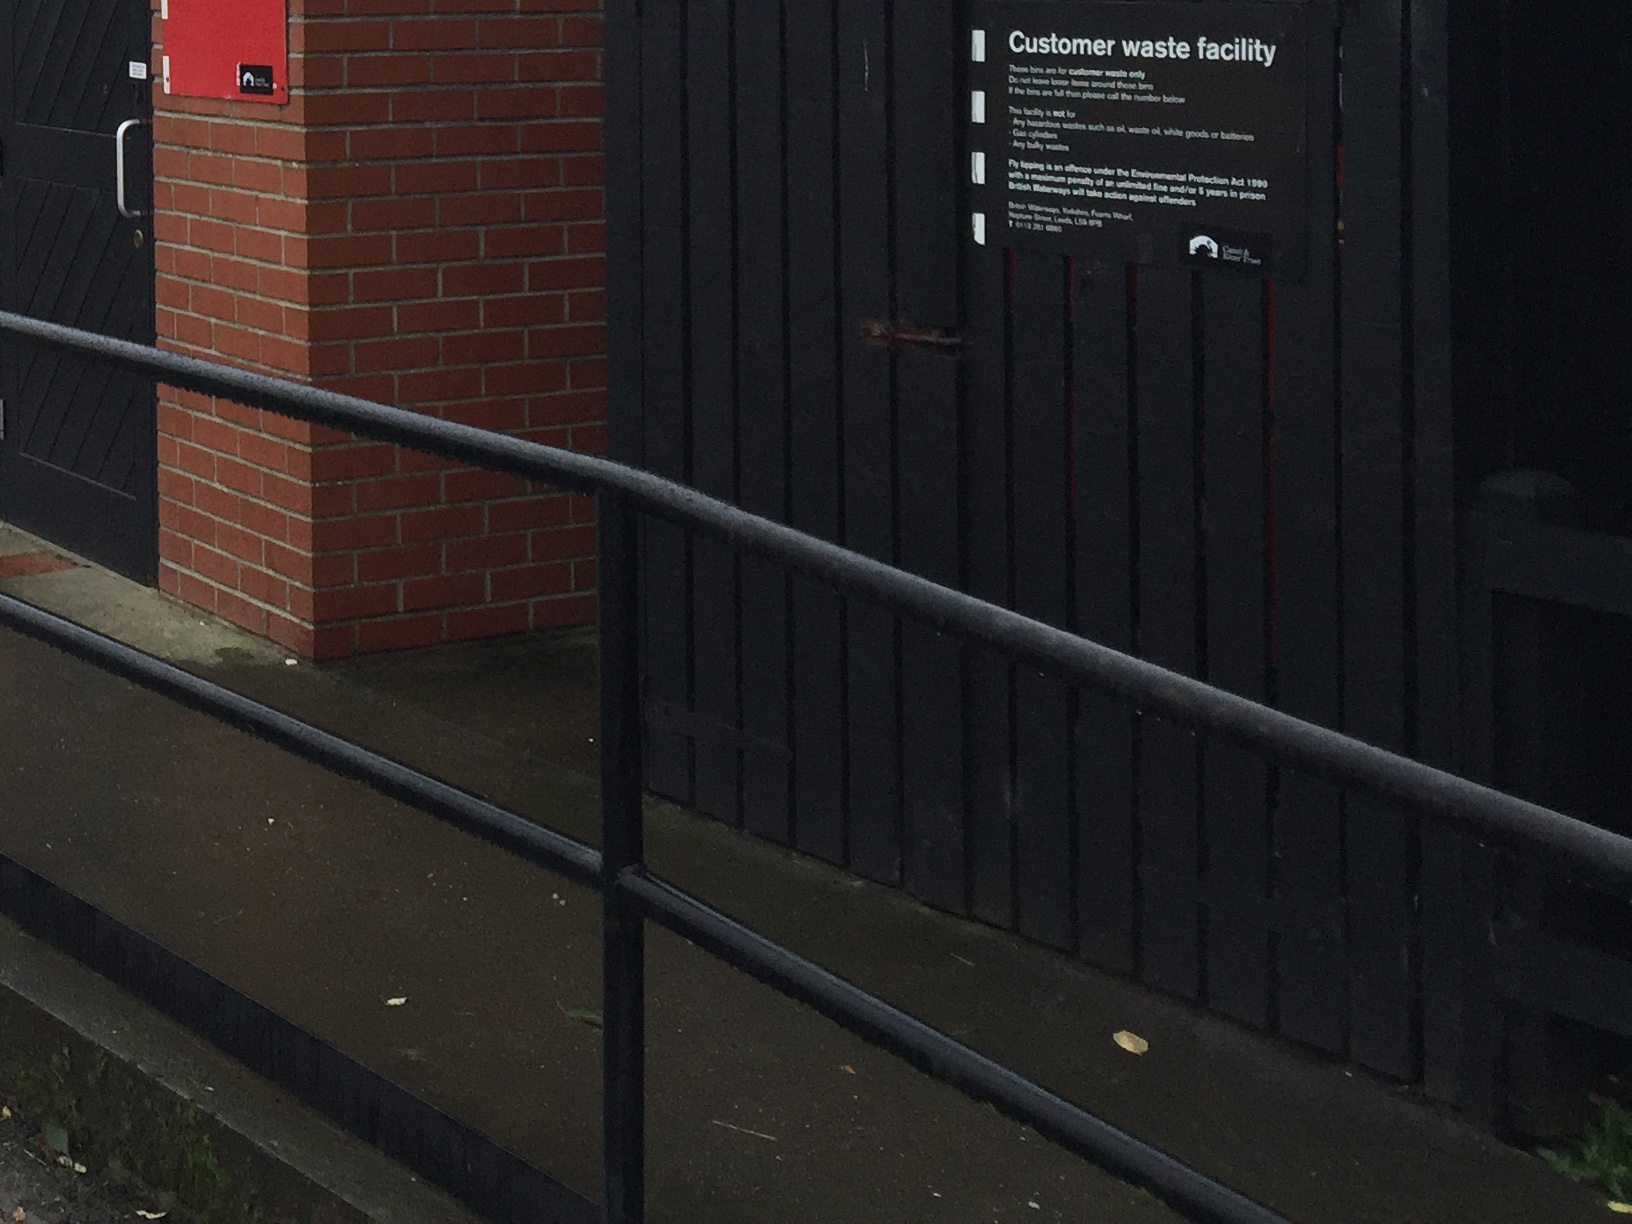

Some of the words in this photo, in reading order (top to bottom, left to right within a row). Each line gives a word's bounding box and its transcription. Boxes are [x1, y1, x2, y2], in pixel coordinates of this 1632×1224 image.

[1009, 30, 1116, 56] Customer
[1121, 36, 1191, 59] waste
[1197, 36, 1277, 67] facility
